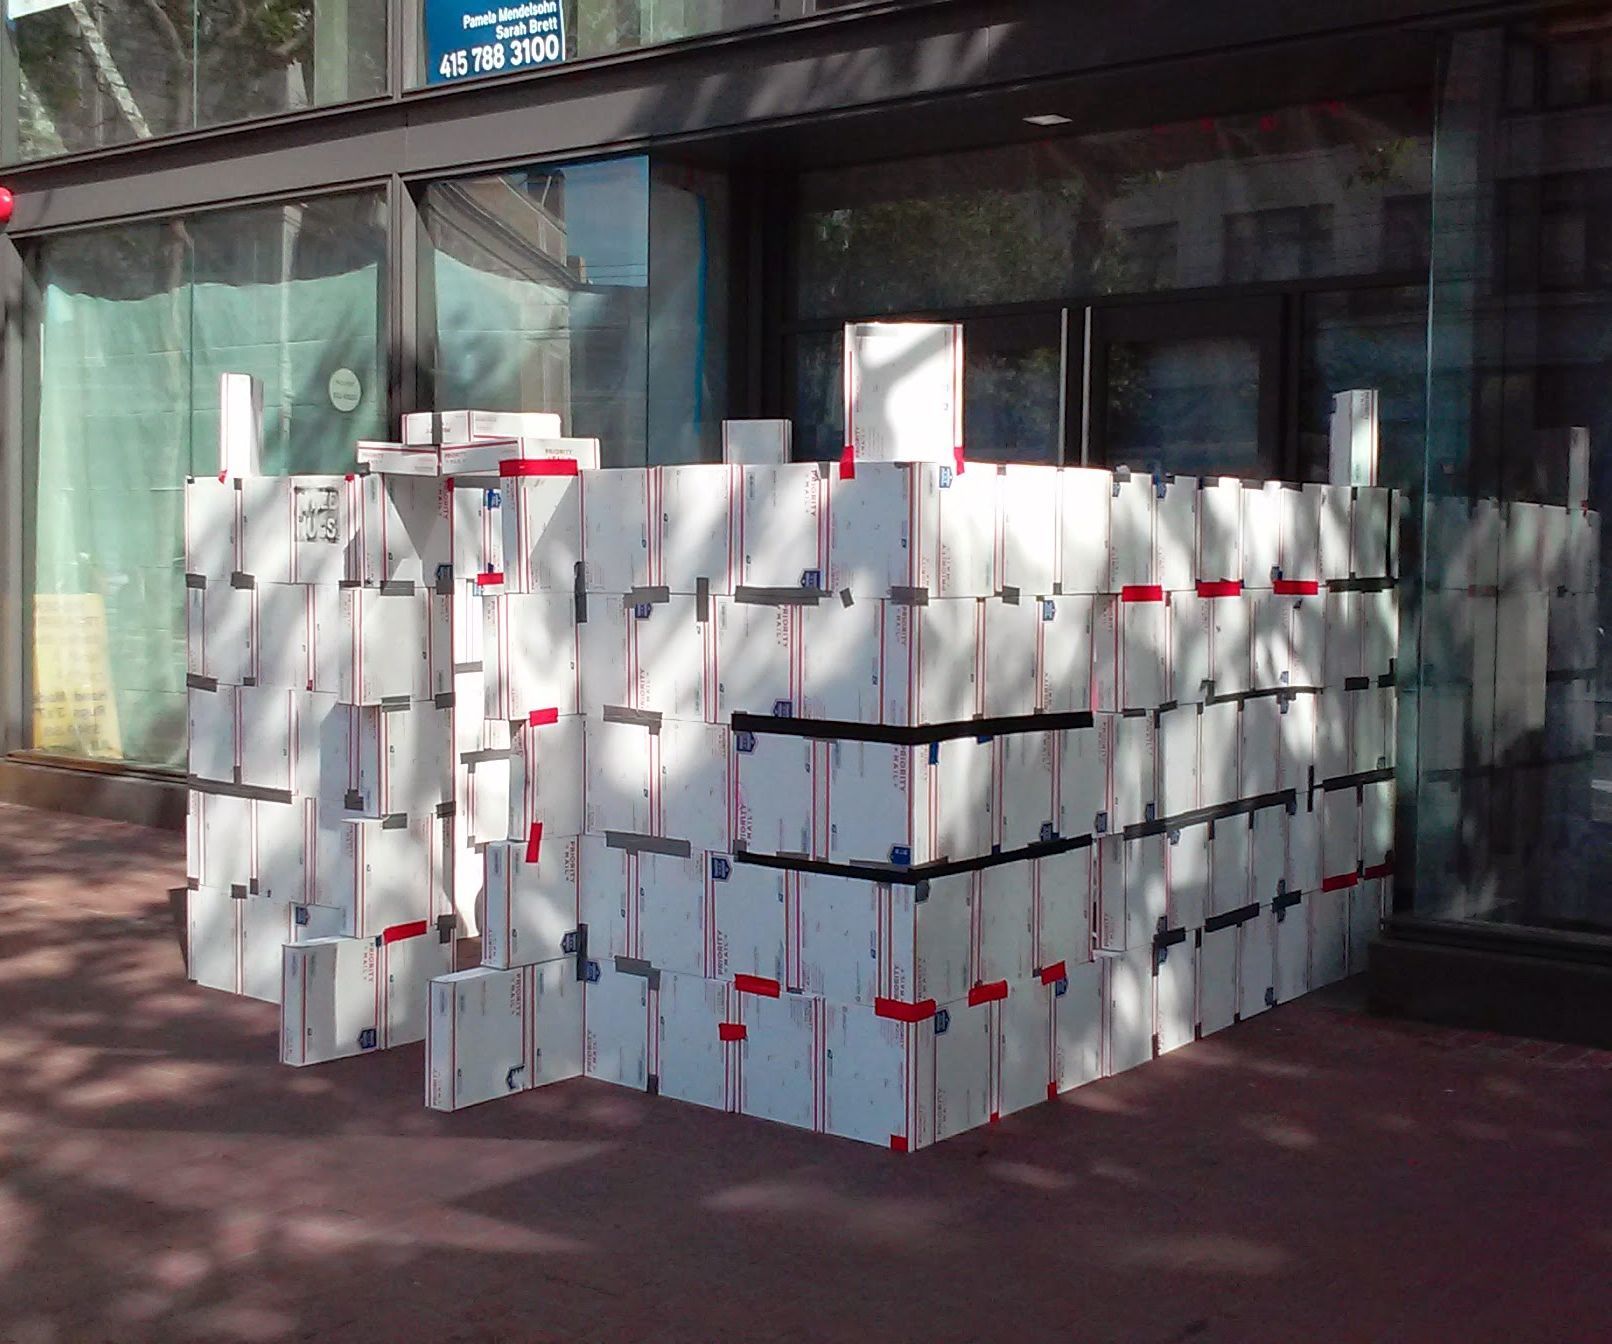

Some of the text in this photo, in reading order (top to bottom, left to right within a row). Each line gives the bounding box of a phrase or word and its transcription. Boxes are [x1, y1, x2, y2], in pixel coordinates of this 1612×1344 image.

[463, 1, 557, 30] Pamela Mendelsohn
[496, 16, 558, 40] Sarah Brett
[440, 34, 560, 78] 415 788 3100
